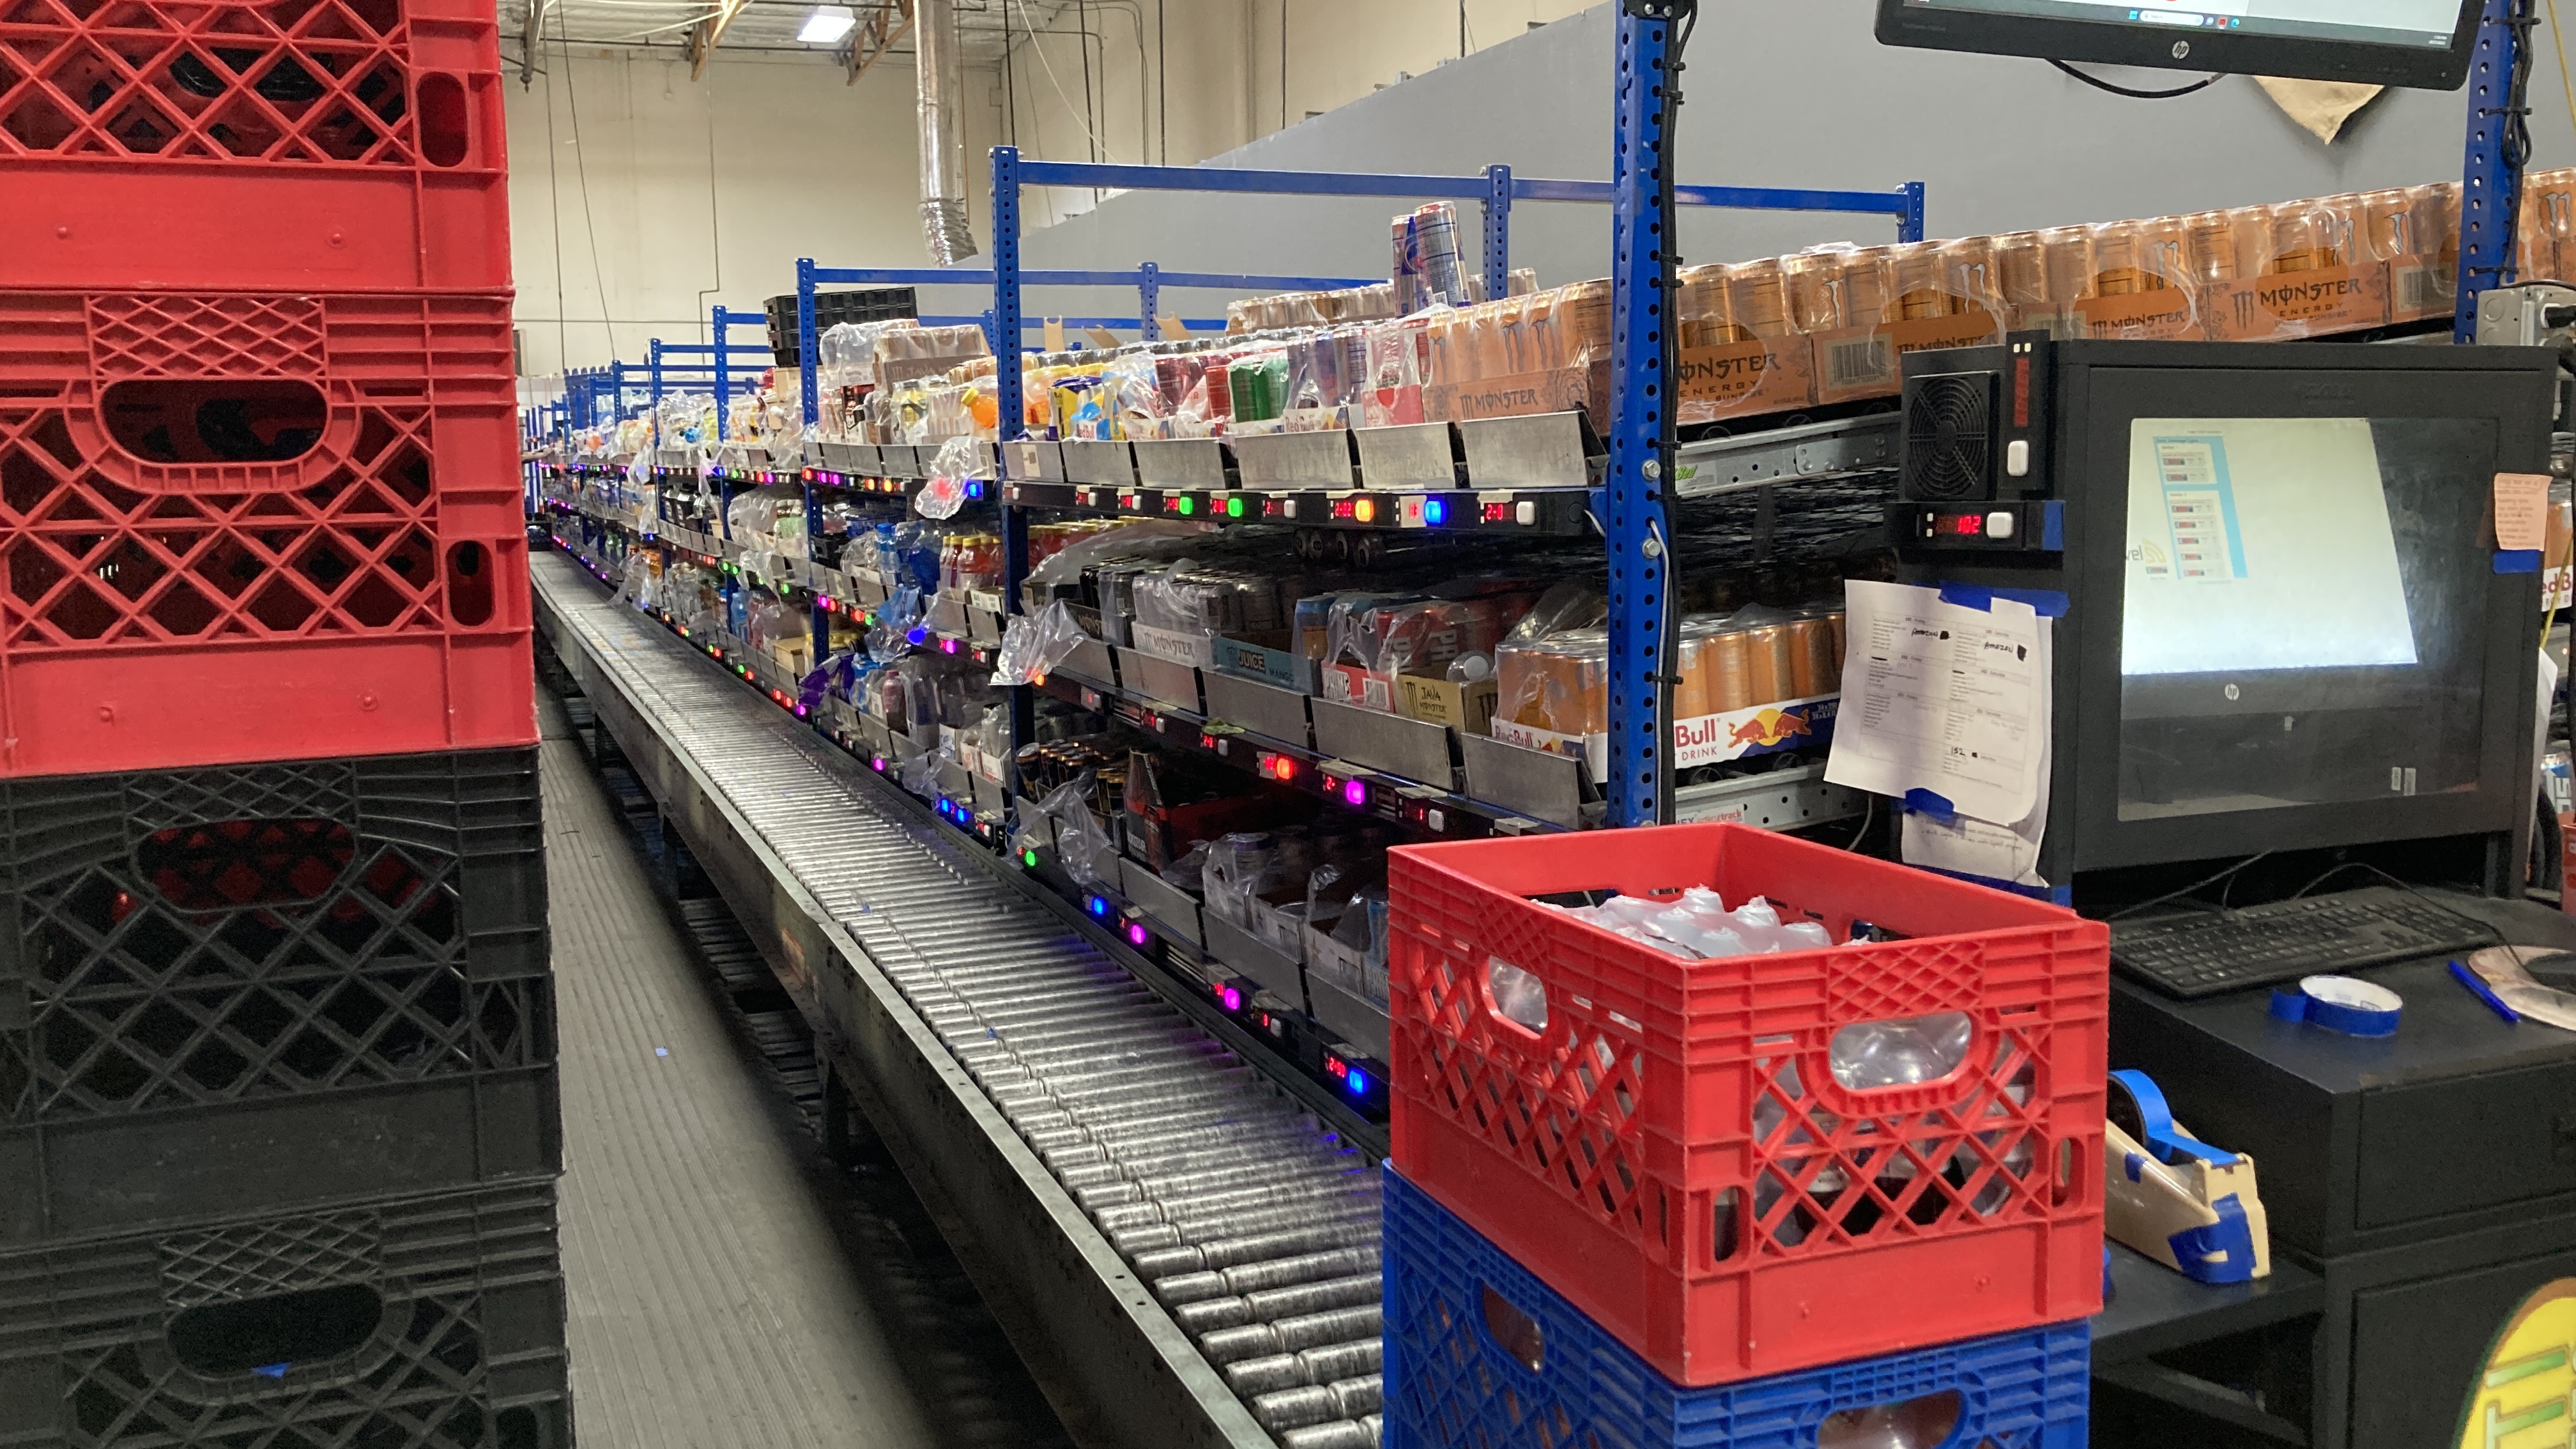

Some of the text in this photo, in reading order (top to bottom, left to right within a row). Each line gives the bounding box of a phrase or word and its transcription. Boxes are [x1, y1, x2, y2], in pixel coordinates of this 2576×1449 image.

[2174, 42, 2189, 58] hp
[2260, 278, 2363, 307] MONSTER
[2279, 302, 2343, 317] ENERGY
[2111, 311, 2186, 332] MONSTER
[1475, 388, 1538, 412] MONSTER
[1957, 514, 1981, 534] 102
[1153, 634, 1195, 659] MONSTER
[1238, 649, 1266, 672] JUICE
[1421, 685, 1441, 702] JAVA
[2225, 683, 2239, 700] hp
[1420, 702, 1447, 714] MONSTER
[1675, 718, 1715, 748] Bull
[1682, 746, 1717, 761] DRINK
